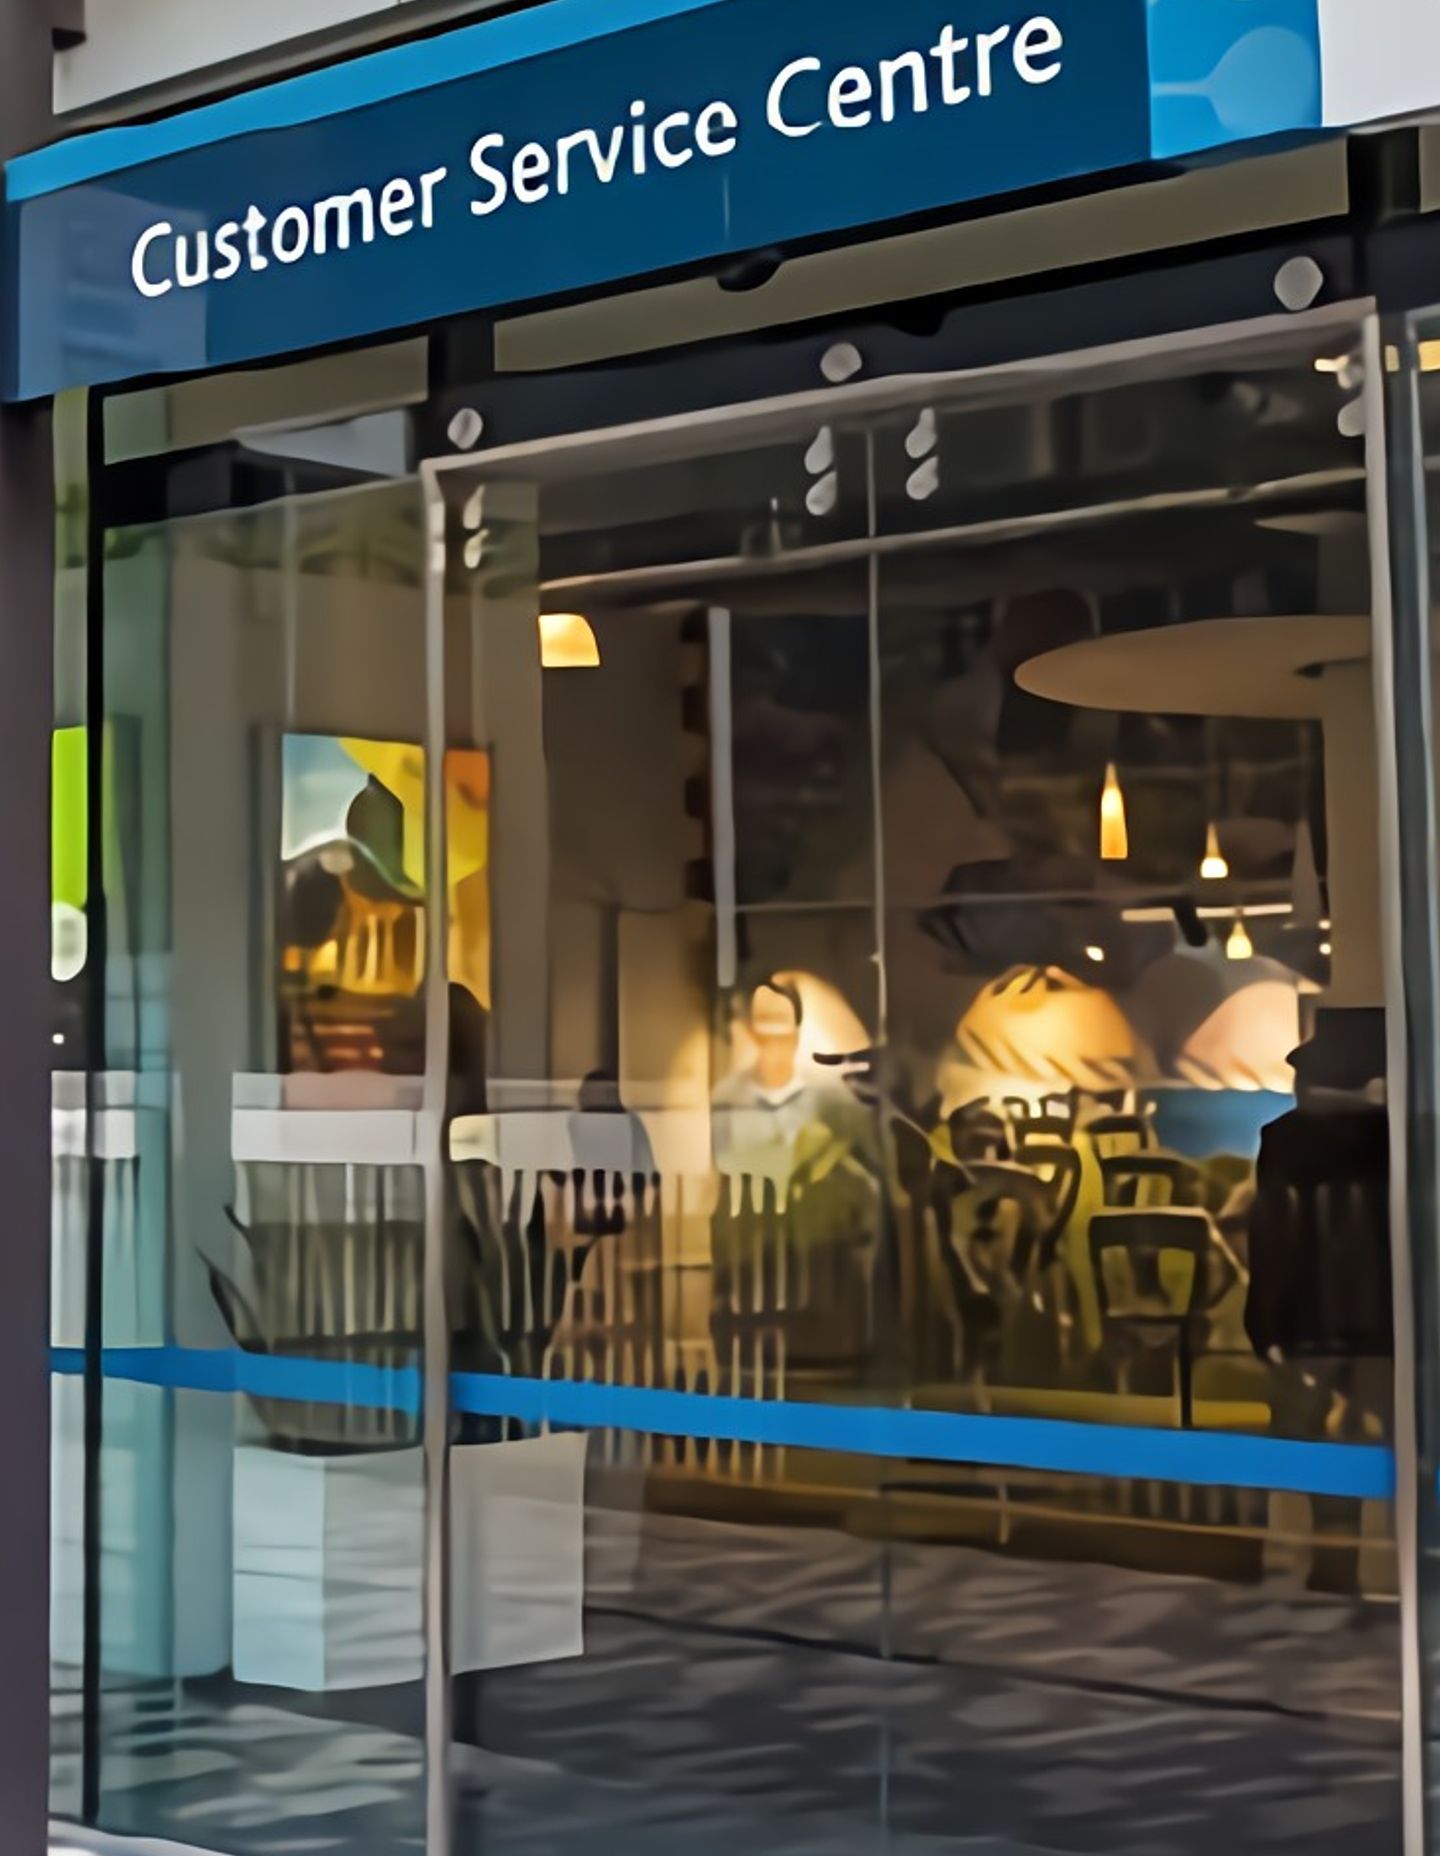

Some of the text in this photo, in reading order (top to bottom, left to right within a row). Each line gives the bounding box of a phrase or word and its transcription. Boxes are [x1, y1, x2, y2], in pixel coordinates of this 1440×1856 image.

[131, 15, 1064, 298] Customer Service Centre
